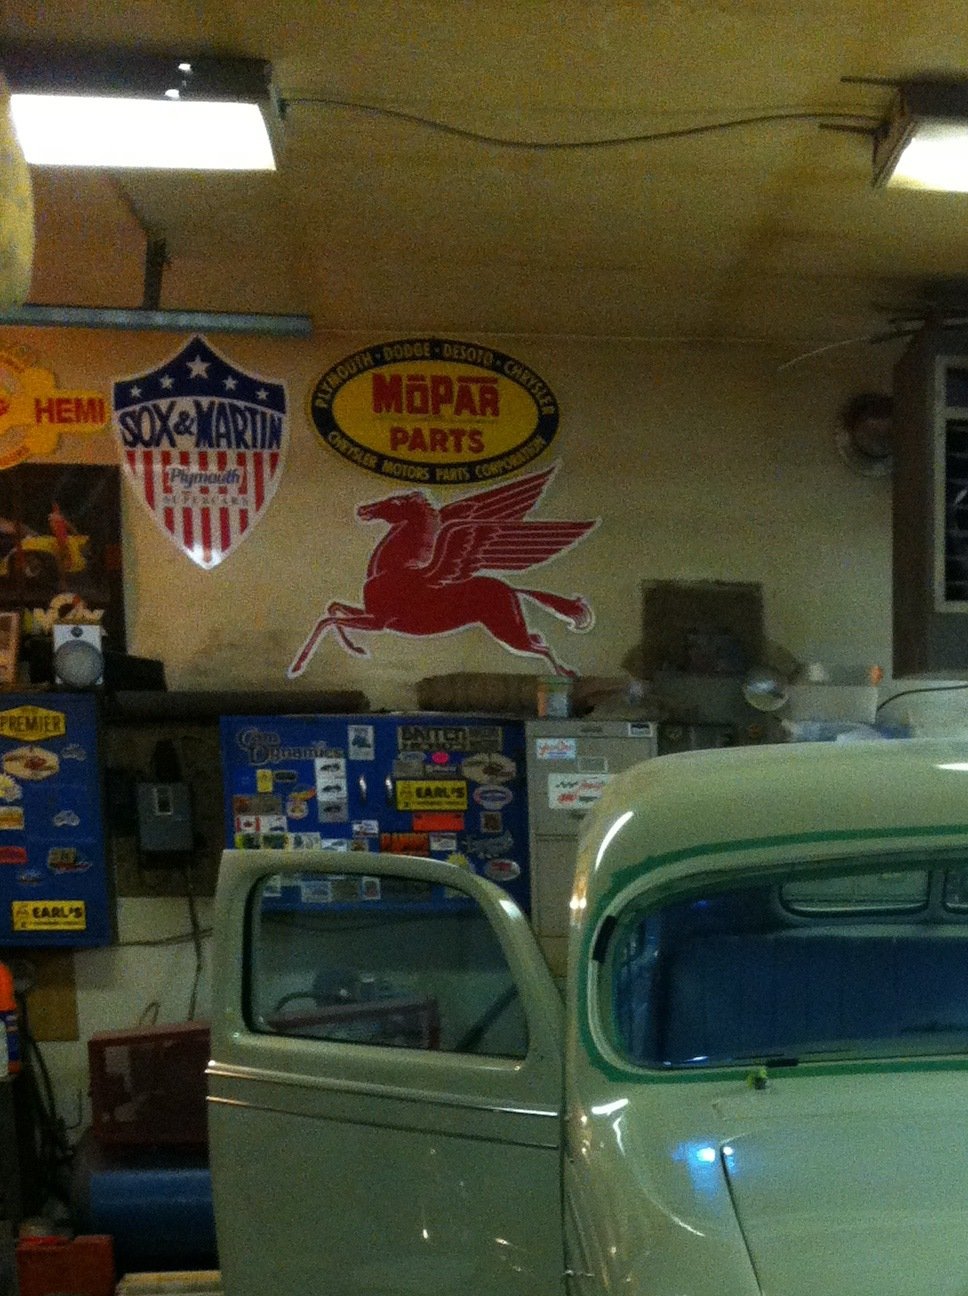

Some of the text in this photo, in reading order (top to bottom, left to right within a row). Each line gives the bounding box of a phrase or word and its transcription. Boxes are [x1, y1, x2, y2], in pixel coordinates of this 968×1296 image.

[314, 341, 557, 416] PLYMOUTH DODGE DESOTO CHRYSLER
[34, 398, 105, 423] HEMI
[389, 426, 485, 454] PARTS
[169, 466, 240, 489] Plymouth
[381, 458, 430, 481] MOTORS
[435, 466, 471, 482] PARTS
[415, 786, 466, 799] EARL'S
[32, 906, 83, 919] EARL'S
